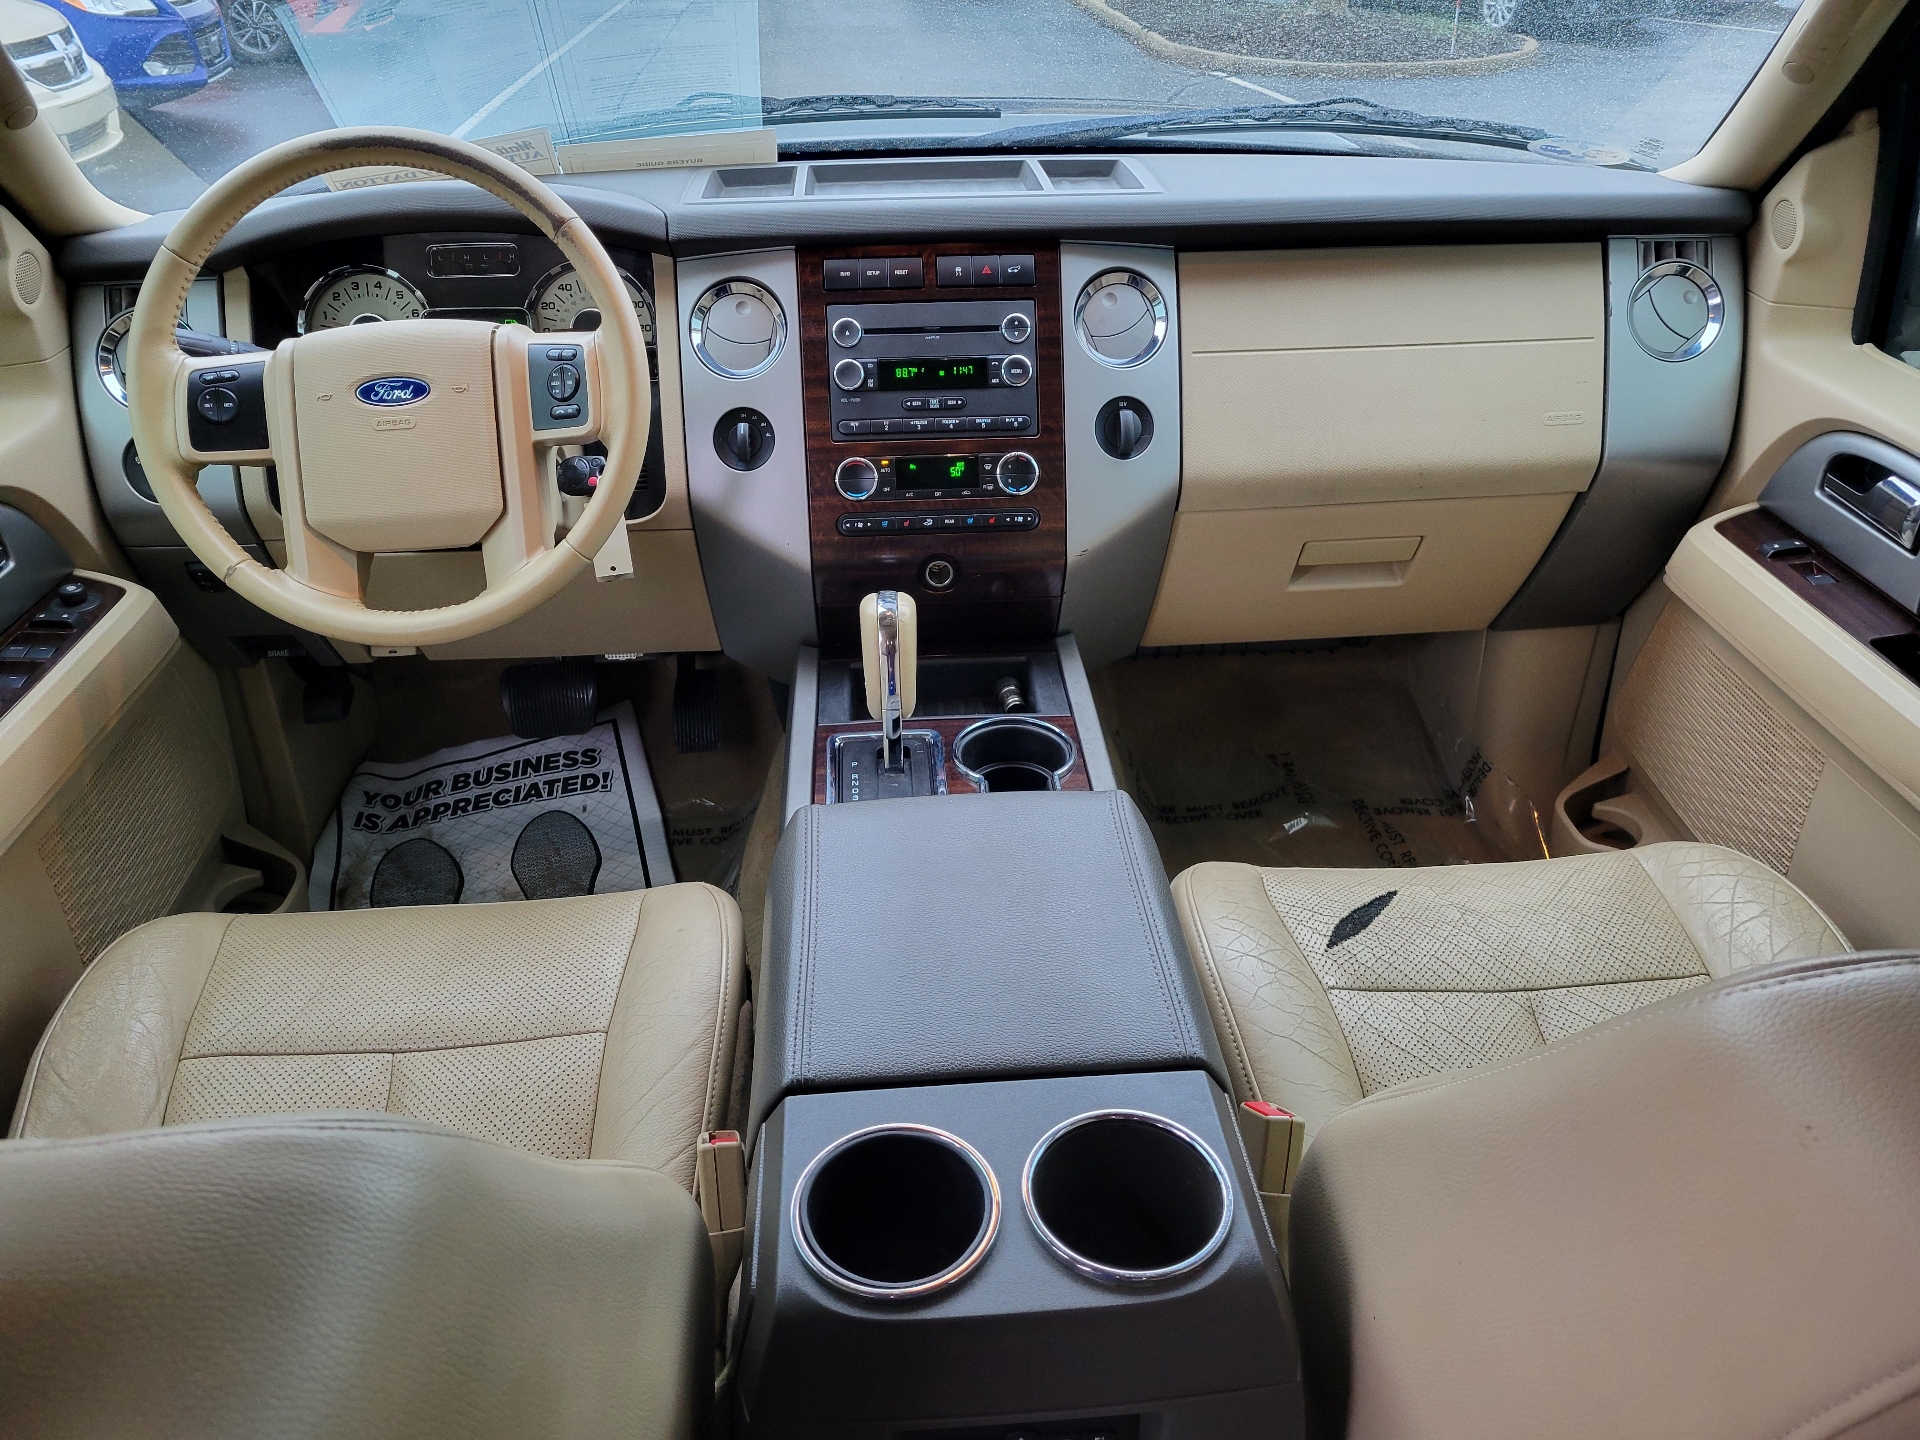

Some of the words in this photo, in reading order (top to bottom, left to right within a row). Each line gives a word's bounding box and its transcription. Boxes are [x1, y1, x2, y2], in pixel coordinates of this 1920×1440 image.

[351, 282, 360, 290] 3
[374, 281, 383, 290] 4
[558, 283, 572, 292] 40
[332, 291, 341, 301] 2
[396, 291, 404, 300] 5
[541, 302, 556, 310] 20
[633, 300, 645, 309] 00
[322, 311, 328, 320] 1
[411, 309, 420, 317] 6
[640, 324, 652, 332] 20
[371, 382, 414, 400] Ford
[376, 419, 411, 427] AIRBAG
[362, 780, 445, 810] YOUR
[450, 749, 601, 793] BUSINESS
[353, 811, 384, 829] IS
[386, 772, 611, 832] APPRECIATED!
[1185, 804, 1224, 814] MUST
[671, 827, 713, 837] MUST
